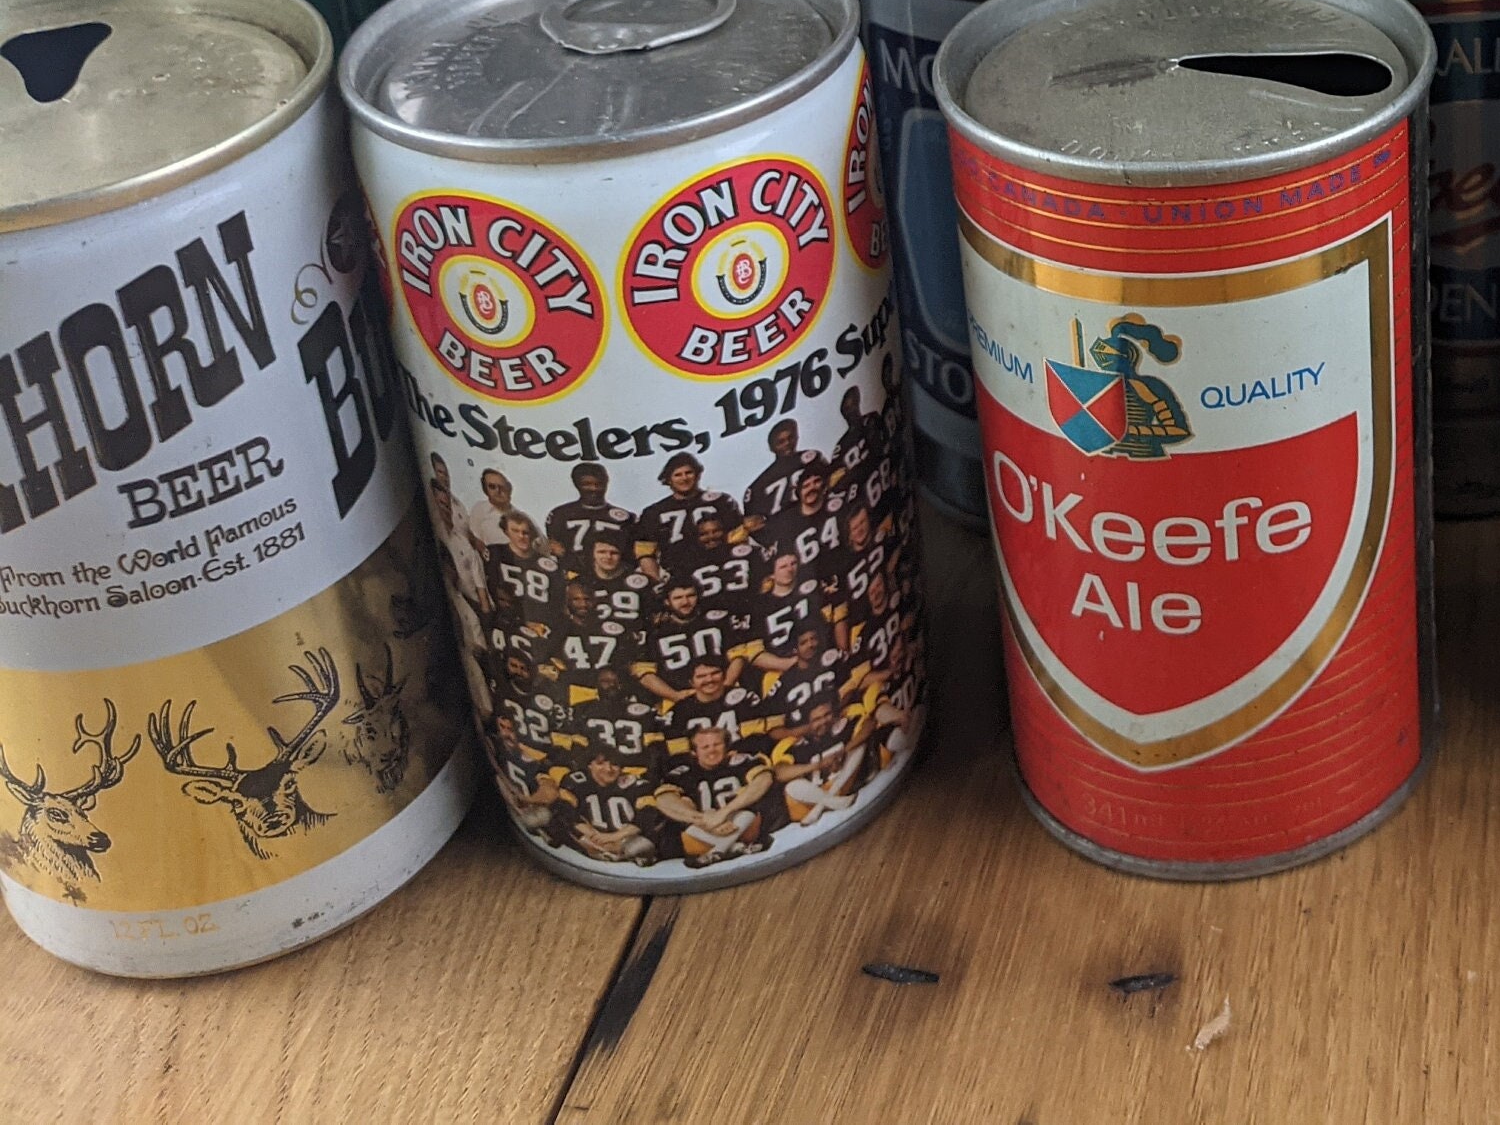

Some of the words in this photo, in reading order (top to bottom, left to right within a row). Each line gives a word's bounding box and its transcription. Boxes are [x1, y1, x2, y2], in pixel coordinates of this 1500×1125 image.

[1143, 196, 1264, 224] UNION
[1279, 163, 1363, 207] MADE
[399, 205, 475, 297] IRON
[487, 216, 594, 319] CITY
[631, 177, 738, 306] IRON
[751, 168, 830, 251] CITY
[679, 286, 815, 366] BEER
[436, 329, 570, 392] BEER
[1200, 361, 1327, 410] QUALITY
[458, 402, 711, 463] Steelers,
[713, 346, 834, 439] 1976
[117, 436, 285, 530] BEER
[993, 450, 1312, 566] O'Keefe
[72, 562, 111, 586] the
[117, 535, 202, 578] World
[204, 496, 299, 561] Famous
[252, 519, 306, 567] 1881
[795, 516, 841, 565] 64
[500, 562, 550, 604] 58
[1071, 572, 1203, 635] Ale
[563, 635, 618, 670] 47
[584, 793, 636, 831] 10
